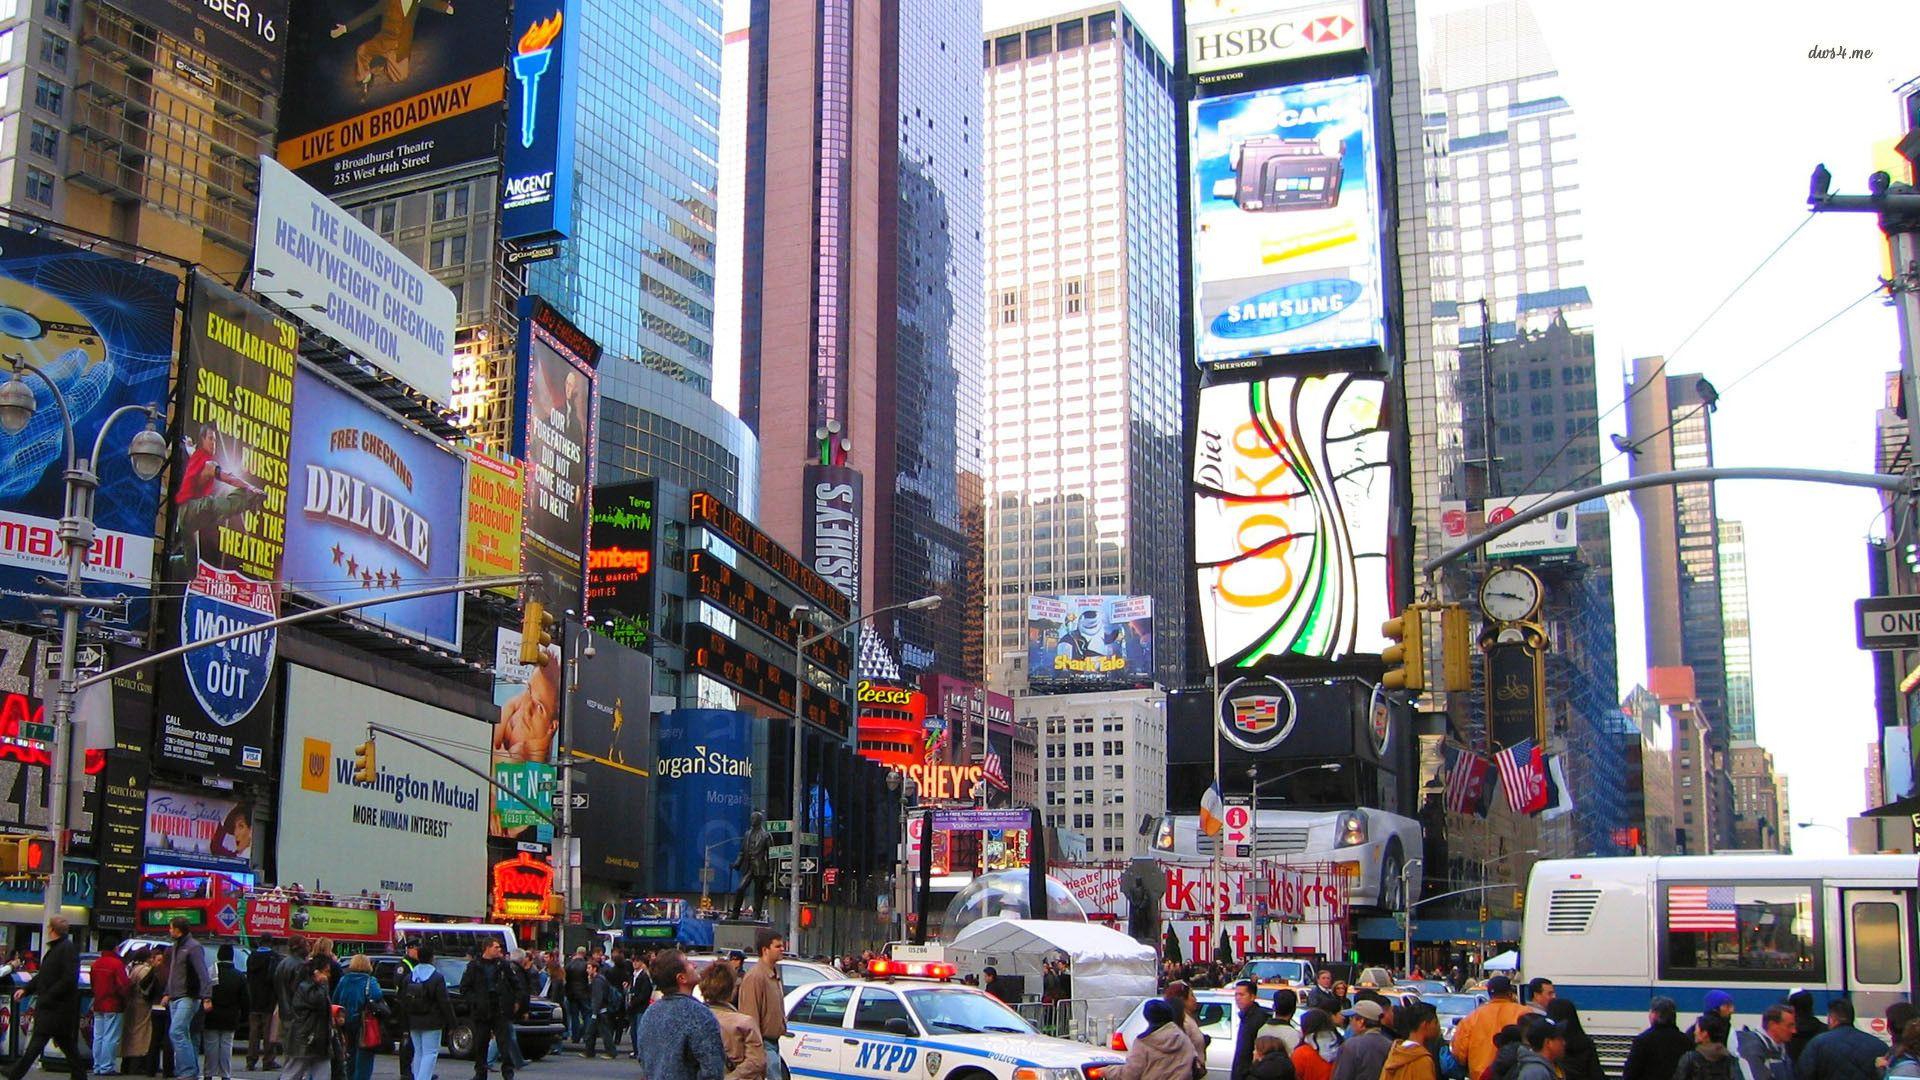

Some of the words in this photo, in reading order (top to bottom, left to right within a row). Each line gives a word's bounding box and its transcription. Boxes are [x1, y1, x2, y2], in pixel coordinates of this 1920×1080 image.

[257, 13, 276, 42] 16
[1195, 22, 1294, 63] HSBC
[1199, 71, 1243, 84] SHERWOOD
[302, 131, 335, 160] LIVE
[340, 120, 364, 147] ON
[369, 84, 472, 137] BROADWAY
[334, 172, 351, 186] 235
[353, 165, 376, 182] West
[378, 161, 400, 176] 44th
[401, 153, 431, 171] Street
[341, 149, 394, 171] Broadhurst
[397, 139, 435, 157] Theatre
[505, 172, 553, 197] ARGENT
[311, 201, 338, 245] THE
[342, 225, 423, 306] UNDISPUTED
[275, 217, 380, 312] HEAVYWEIGHT
[383, 292, 444, 355] CHECKING
[1228, 293, 1344, 324] SAMSUNG
[273, 318, 296, 349] “SO
[326, 292, 400, 363] CHAMPION.
[206, 312, 293, 378] EXHILARATING
[1213, 360, 1257, 371] SHERWOOD
[267, 376, 292, 404] AND
[192, 395, 205, 425] IT
[208, 399, 290, 460] PRACTICALLY
[549, 407, 566, 434] OUR
[533, 415, 581, 464] FOREFATHERS
[242, 446, 288, 488] BURSTS
[330, 428, 358, 452] FREE
[361, 432, 413, 495] CHECKING
[477, 456, 501, 473] Container
[541, 448, 554, 471] DID
[555, 455, 570, 478] NOT
[1199, 429, 1224, 488] Diet
[263, 483, 287, 515] OUT
[496, 482, 522, 513] Stuffer
[534, 463, 555, 492] COME
[556, 478, 575, 505] HERE
[303, 465, 430, 568] DELUXE
[468, 501, 515, 535] pectacular!
[539, 487, 549, 511] TO
[548, 495, 570, 524] RENT.
[1216, 420, 1293, 608] Coke
[243, 510, 260, 534] OF
[263, 512, 285, 542] THE
[1495, 540, 1519, 549] mobile
[1519, 538, 1546, 549] phones
[16, 553, 56, 566] Expanding
[206, 577, 238, 602] THARP
[852, 562, 861, 603] Milk
[249, 592, 272, 612] JOEL
[194, 608, 269, 657] MOVIN'
[78, 652, 95, 661] WAY
[1054, 654, 1096, 672] Shark
[1099, 654, 1125, 672] Tale
[206, 660, 249, 699] OUT
[857, 680, 912, 704] Reese's
[31, 725, 38, 735] 7
[165, 714, 181, 726] CALL
[17, 738, 45, 750] MUSICA
[246, 752, 259, 760] VISA
[657, 755, 706, 778] organ
[893, 763, 983, 799] SHEY'S
[336, 757, 429, 804] Whington
[431, 778, 479, 812] Mutual
[497, 769, 552, 803] RENT
[151, 812, 192, 838] WONDERFUL
[353, 804, 377, 826] MORE
[379, 810, 408, 831] HUMAN
[410, 815, 449, 838] INTEREST
[72, 833, 91, 844] Sprint
[380, 879, 413, 893] wamu.com
[503, 869, 545, 893] ROXY
[251, 913, 285, 928] Sightseeing
[255, 903, 269, 912] New
[855, 1042, 918, 1074] NYPD
[988, 1052, 1017, 1065] POLICE
